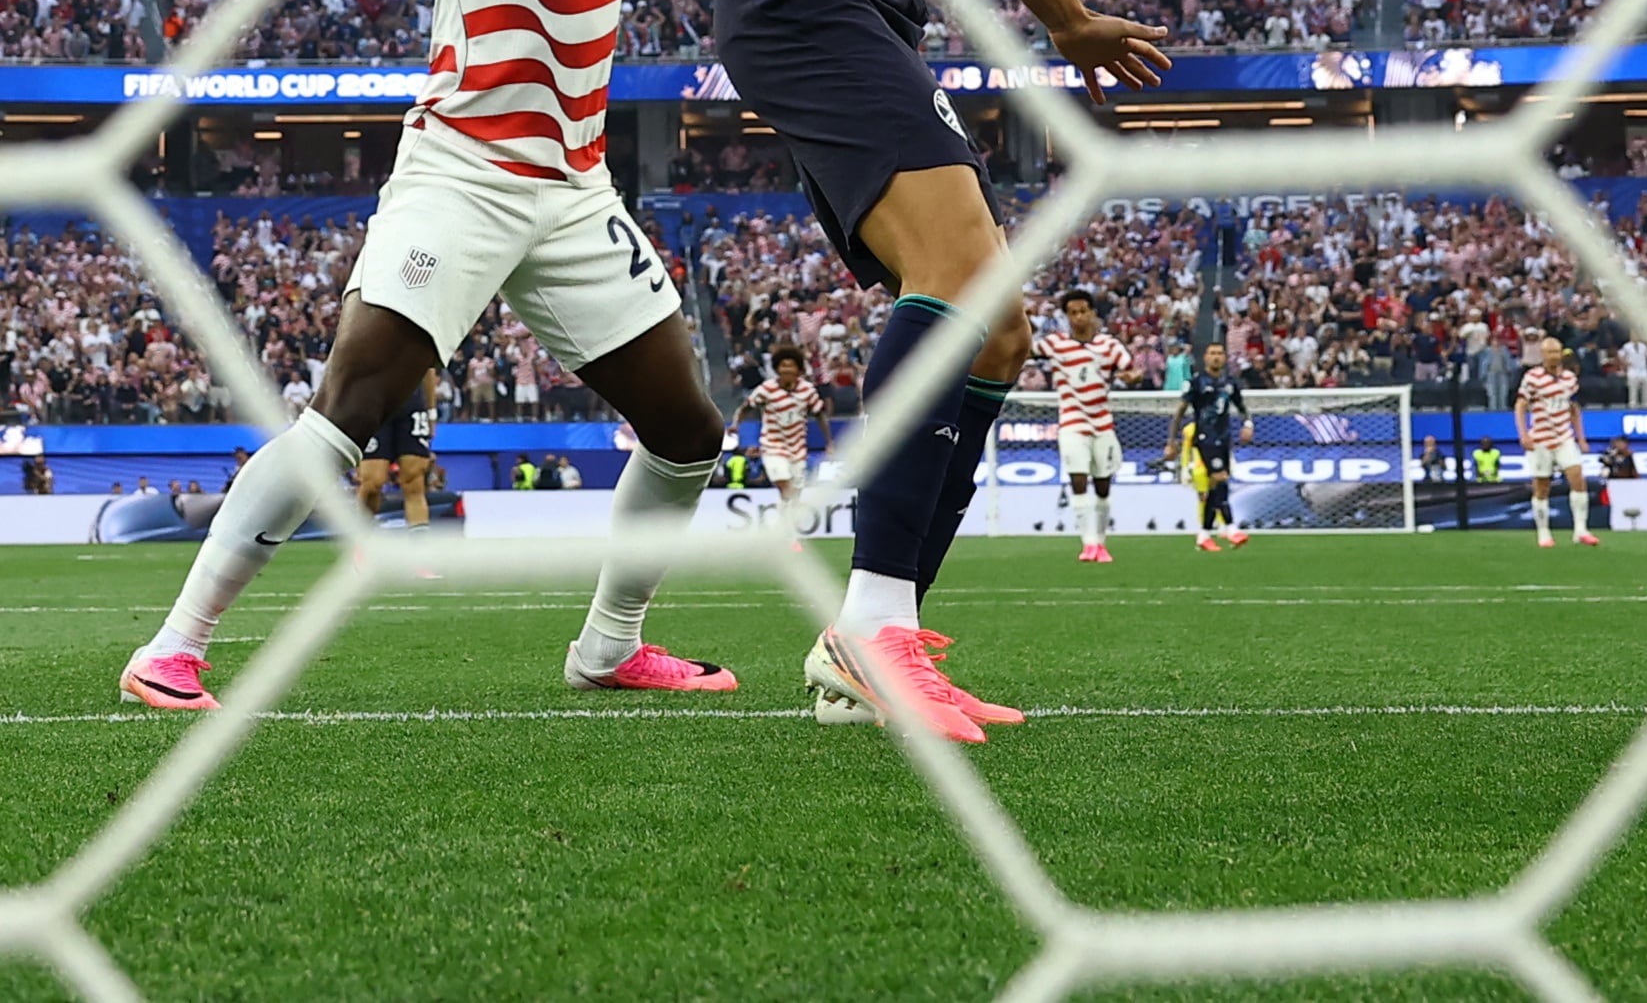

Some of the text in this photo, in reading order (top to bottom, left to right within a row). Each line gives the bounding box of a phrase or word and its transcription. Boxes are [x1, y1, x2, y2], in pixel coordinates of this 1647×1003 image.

[123, 73, 182, 97] FIFA
[183, 74, 280, 98] WORLD
[280, 74, 336, 98] CUP
[930, 64, 1118, 90] OS ANGELS
[409, 248, 438, 269] USA
[998, 421, 1059, 442] ANGE
[1232, 458, 1391, 484] CUP
